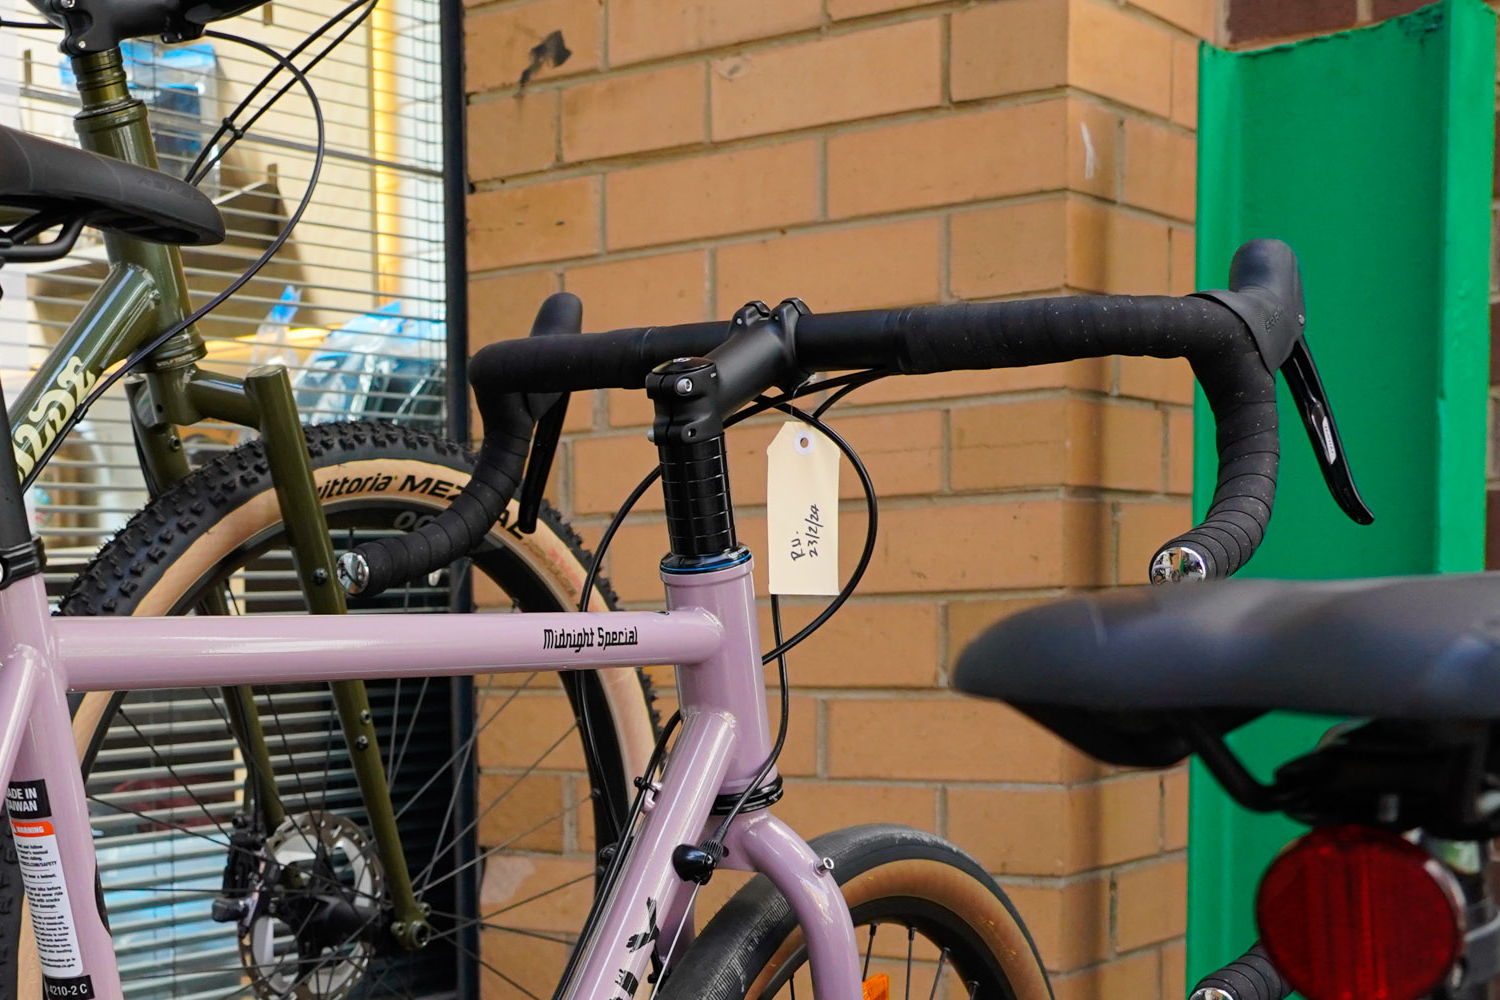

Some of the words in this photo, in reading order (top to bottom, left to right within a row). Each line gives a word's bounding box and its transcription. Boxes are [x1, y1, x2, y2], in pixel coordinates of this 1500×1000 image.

[543, 627, 595, 653] Midnight
[597, 626, 639, 651] Special
[6, 787, 24, 799] ADE
[24, 787, 38, 799] IN
[80, 983, 88, 994] C
